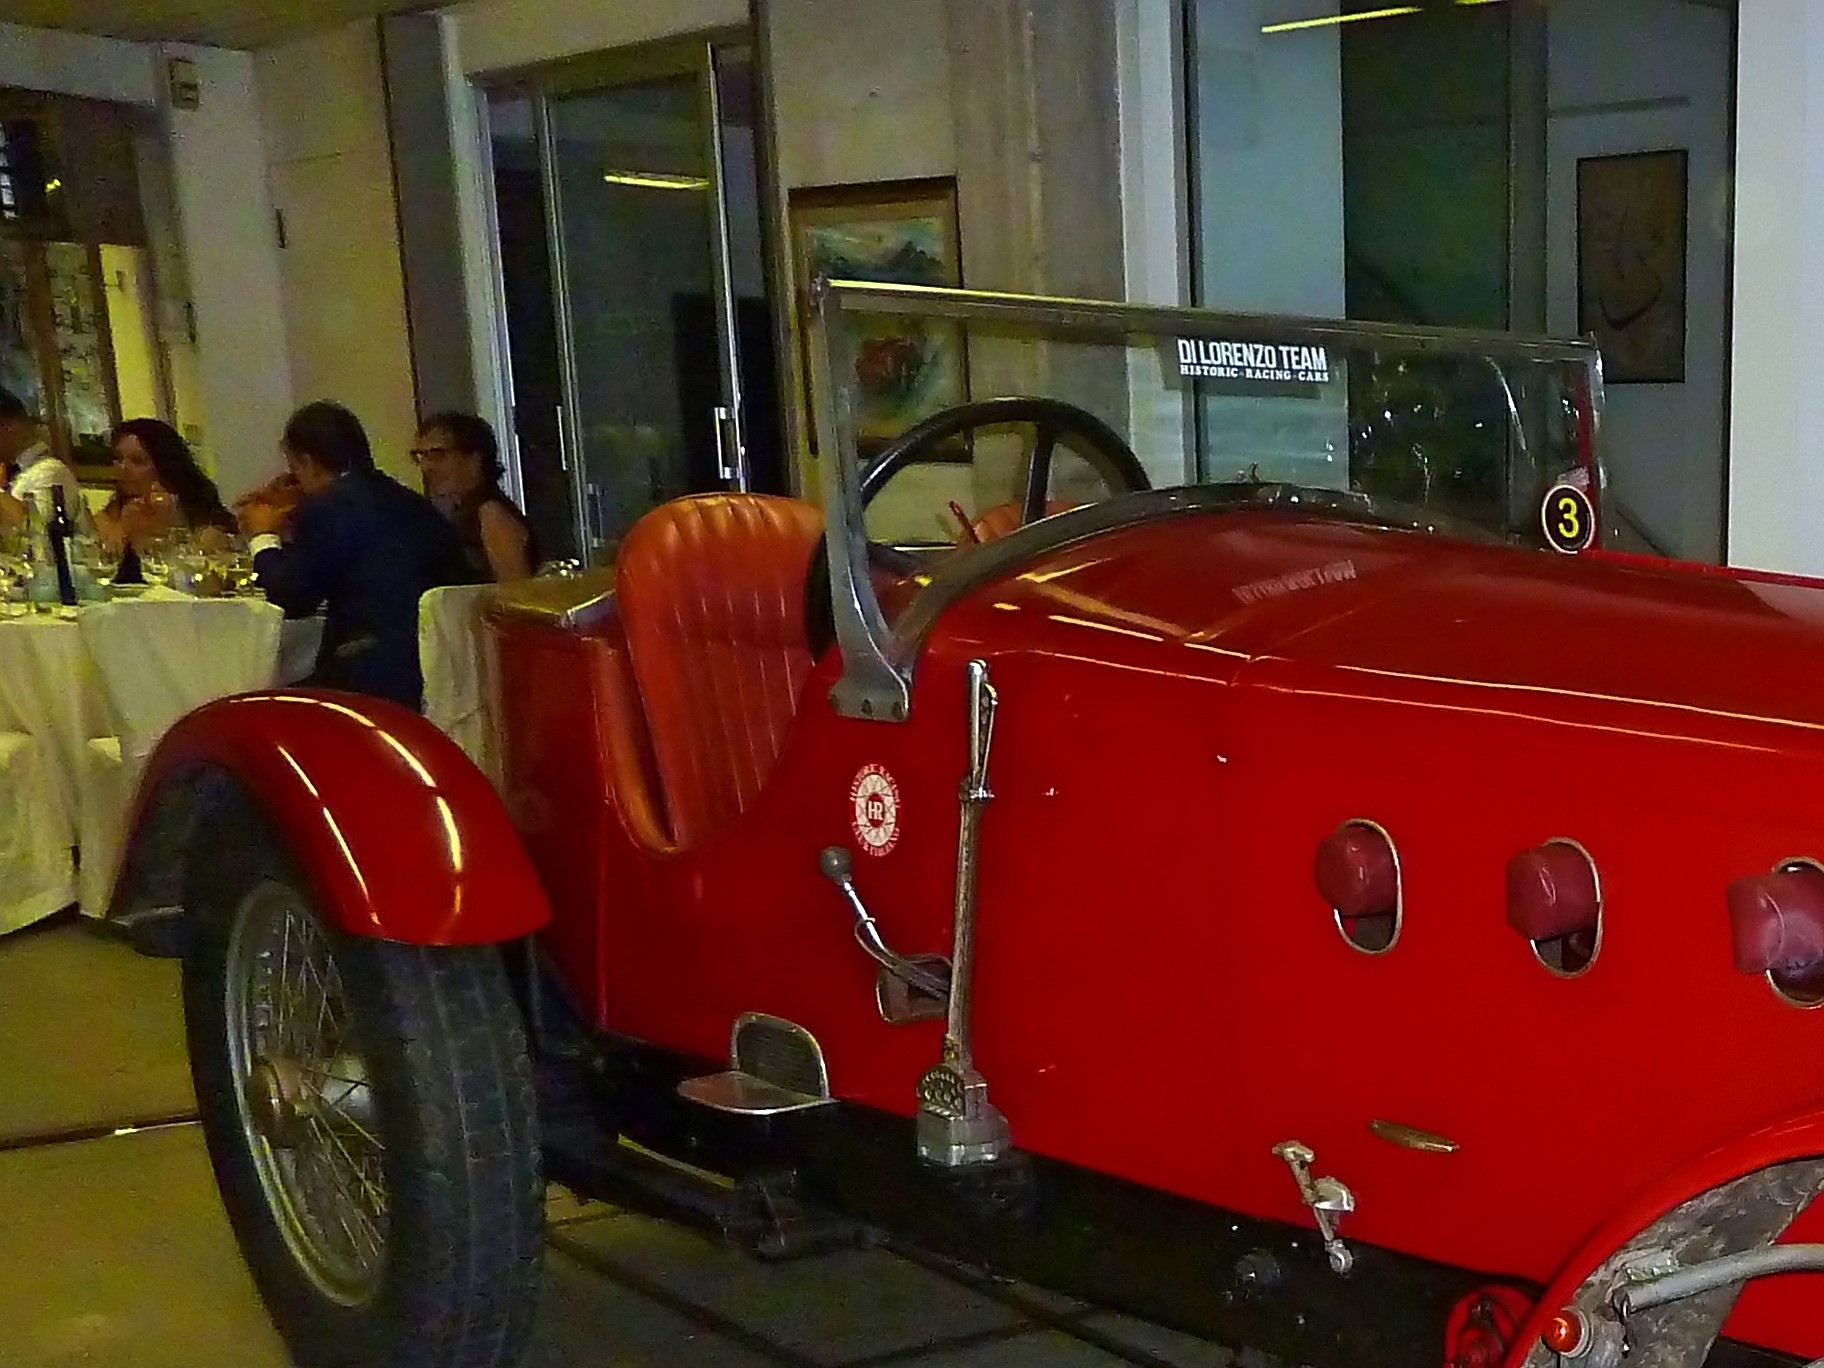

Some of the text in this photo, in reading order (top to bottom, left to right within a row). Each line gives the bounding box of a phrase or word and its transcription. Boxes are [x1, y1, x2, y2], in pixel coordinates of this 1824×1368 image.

[1177, 339, 1327, 371] DI LORENZO TEAM
[1179, 364, 1329, 382] HISTORIC RACING CARS
[1558, 497, 1579, 538] 3
